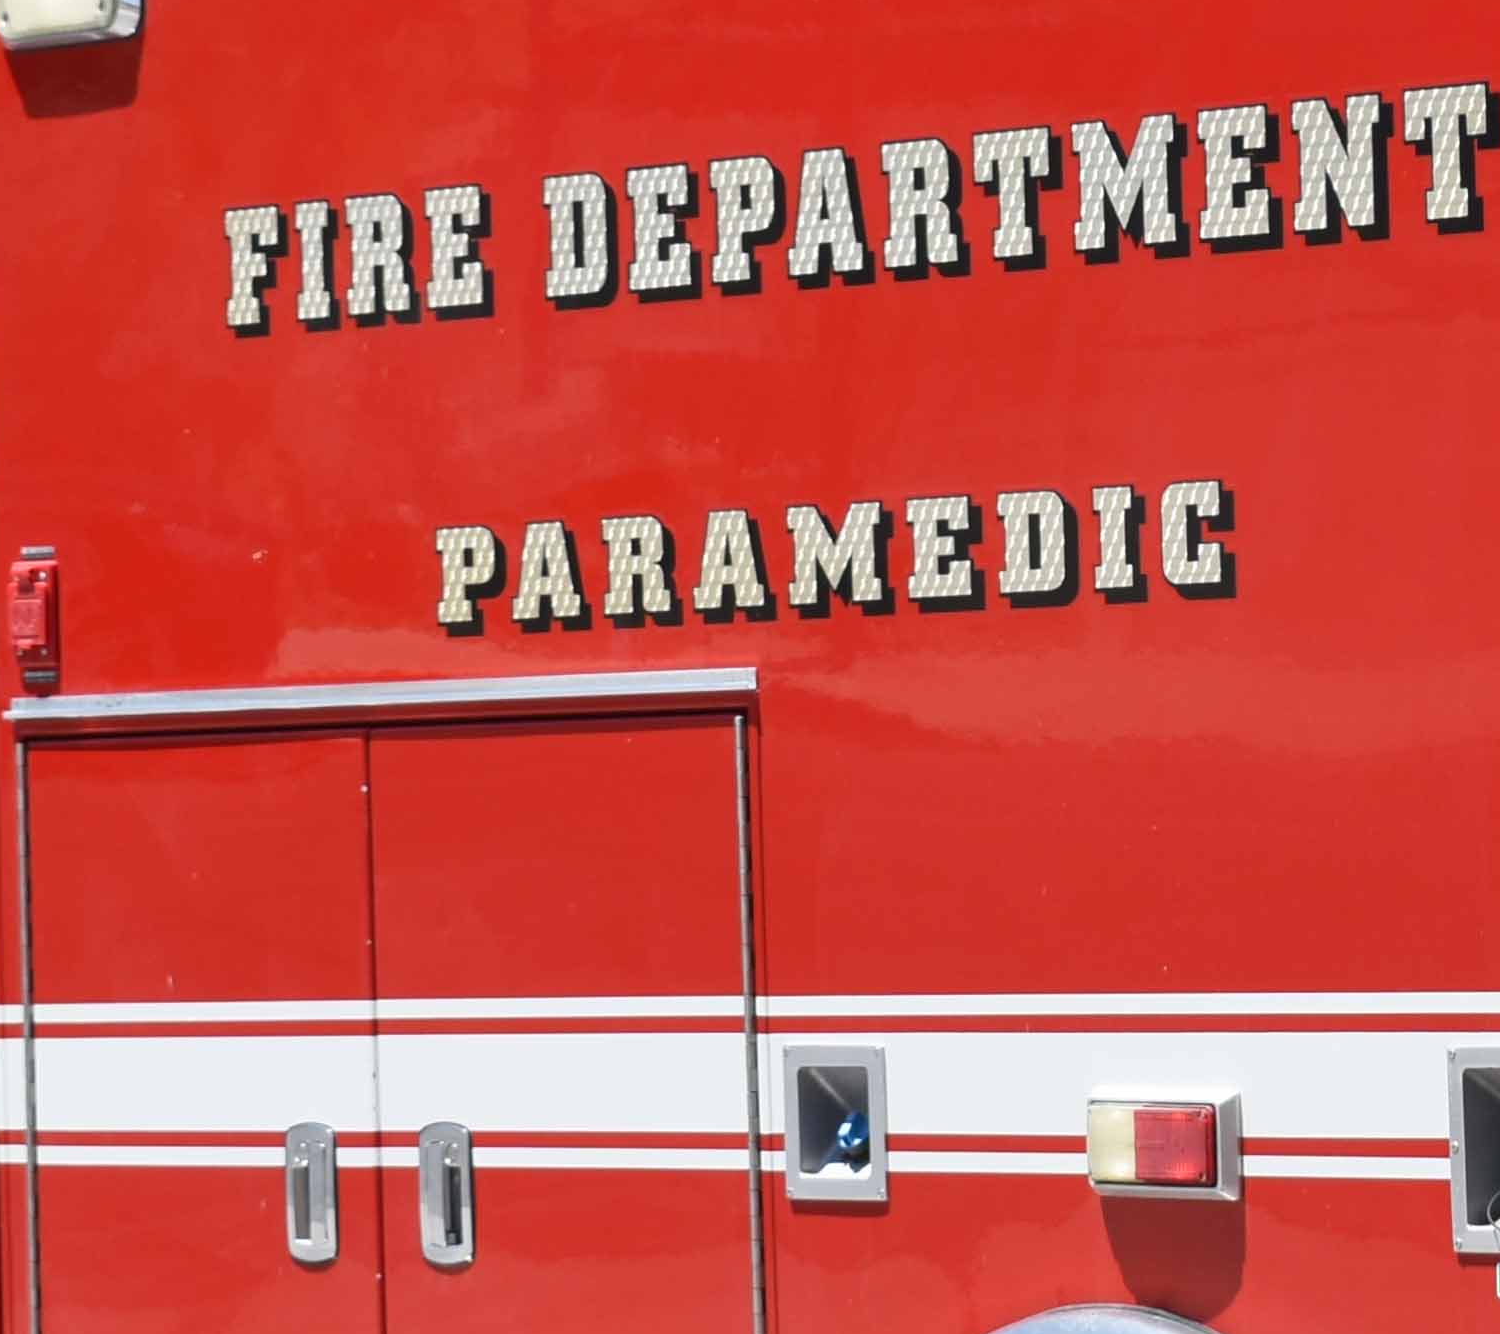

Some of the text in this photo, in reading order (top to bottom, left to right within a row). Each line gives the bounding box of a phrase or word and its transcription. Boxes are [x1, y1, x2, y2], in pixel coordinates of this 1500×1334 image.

[224, 82, 1498, 333] FIRE DEPARTMENT
[434, 479, 1232, 633] PARAMEDIC
